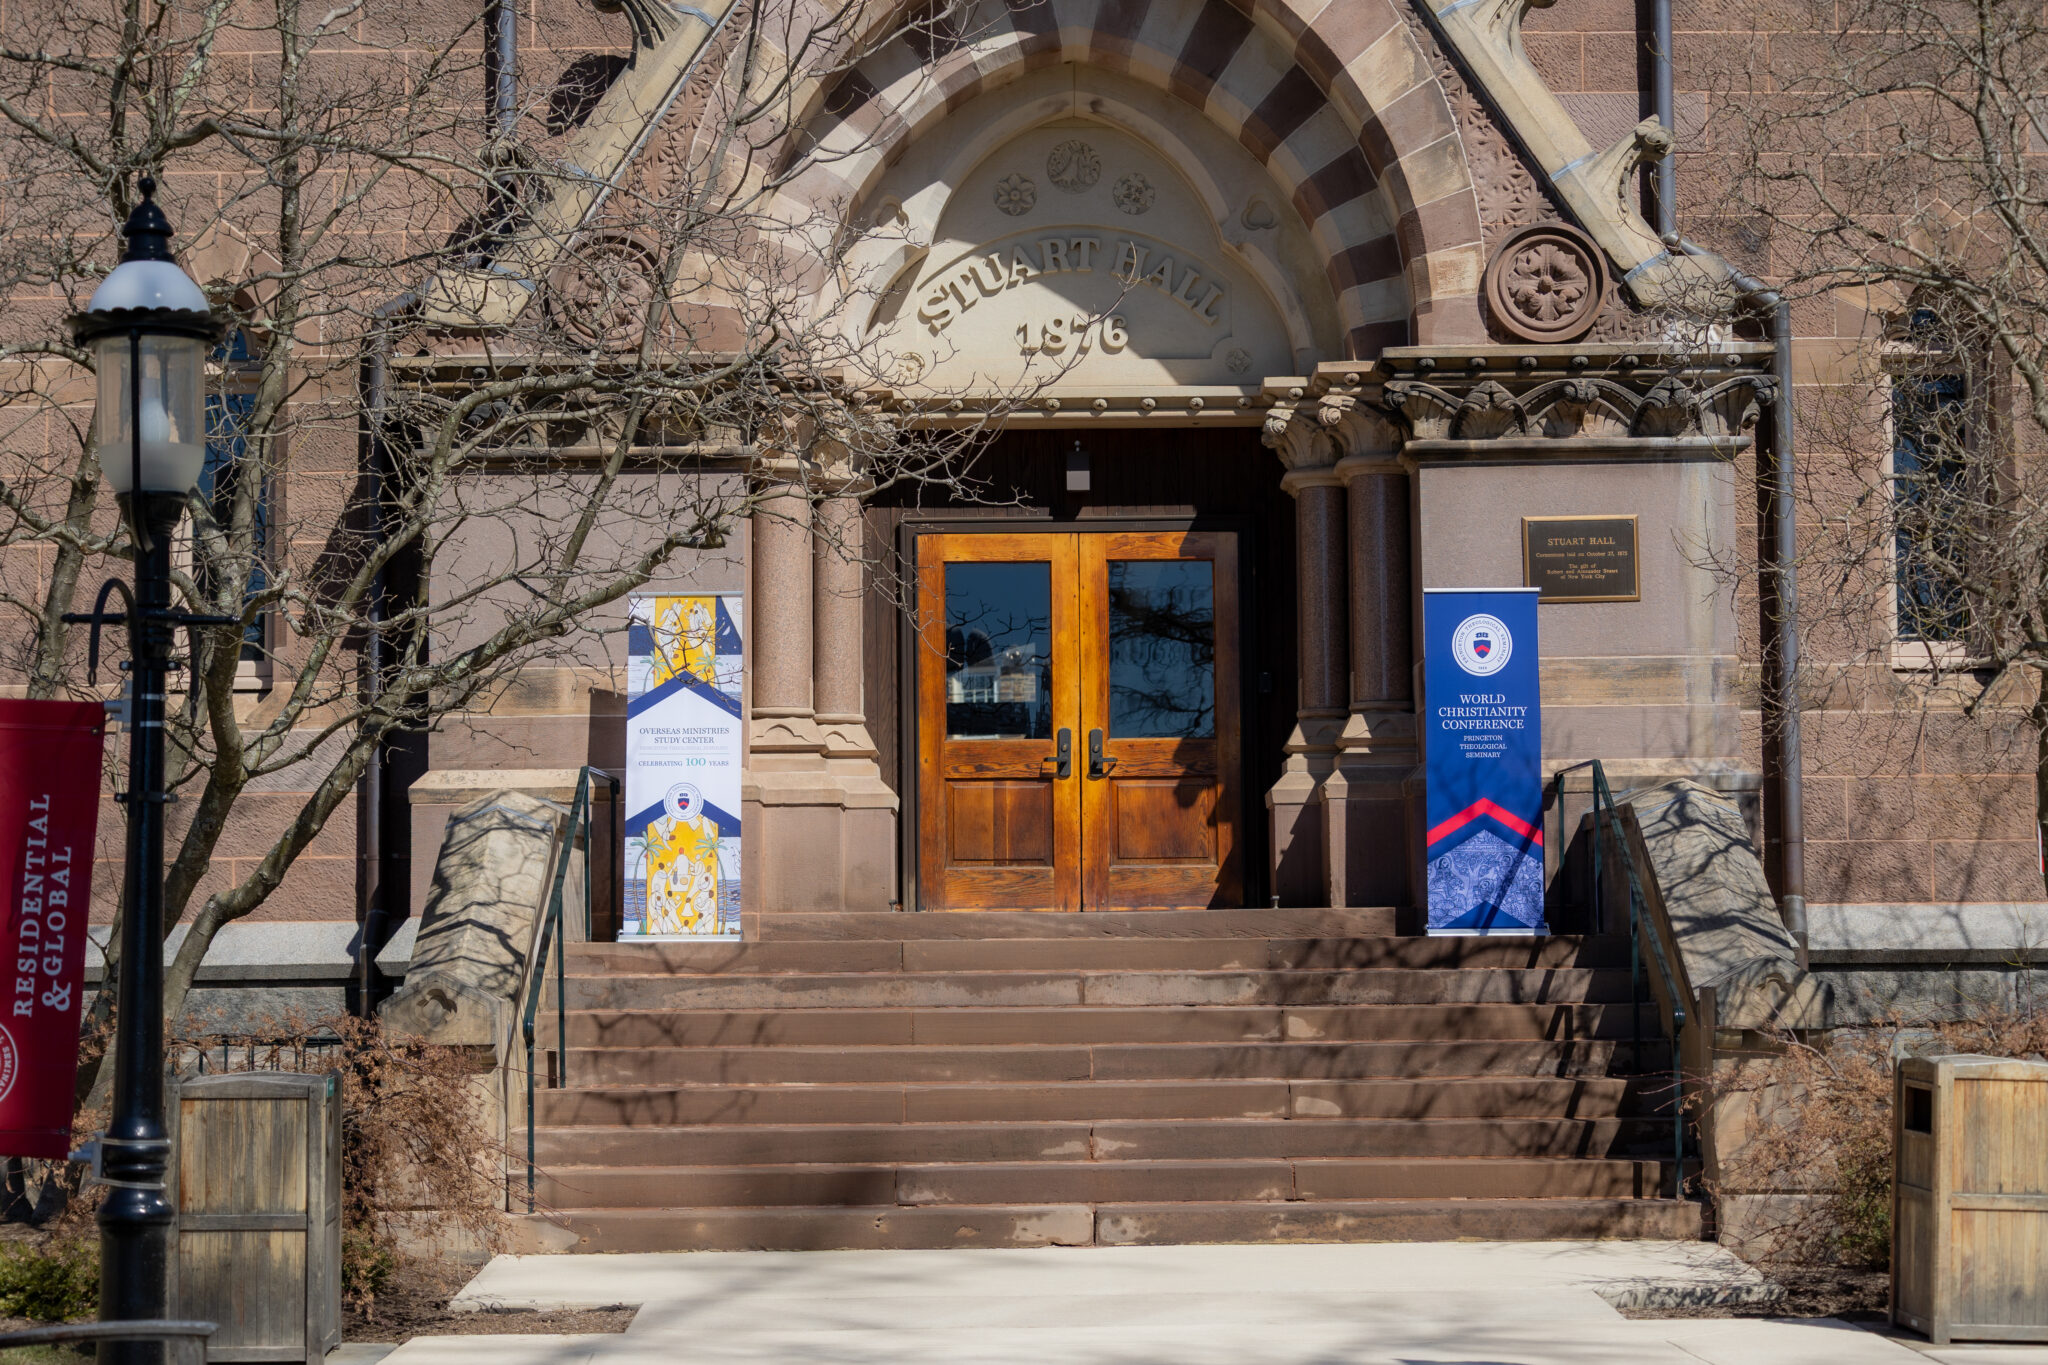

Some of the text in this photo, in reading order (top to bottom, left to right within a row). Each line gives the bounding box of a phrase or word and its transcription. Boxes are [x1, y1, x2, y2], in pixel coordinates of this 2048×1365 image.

[917, 237, 1224, 332] STUART HALL
[1016, 313, 1128, 351] 1876
[1547, 536, 1616, 546] STUART HALL
[1459, 694, 1506, 704] WORLD
[1438, 706, 1528, 717] CHRISTIANITY
[1441, 719, 1525, 730] CONFERENCE
[639, 727, 730, 735] OVERSEAS MINISTRIES
[654, 736, 715, 744] STUDY CENTER
[685, 757, 707, 767] 100
[13, 794, 50, 1018] RESIDENTIAL
[41, 846, 72, 1012] & GLOBAL
[0, 1046, 12, 1092] SEMINA
